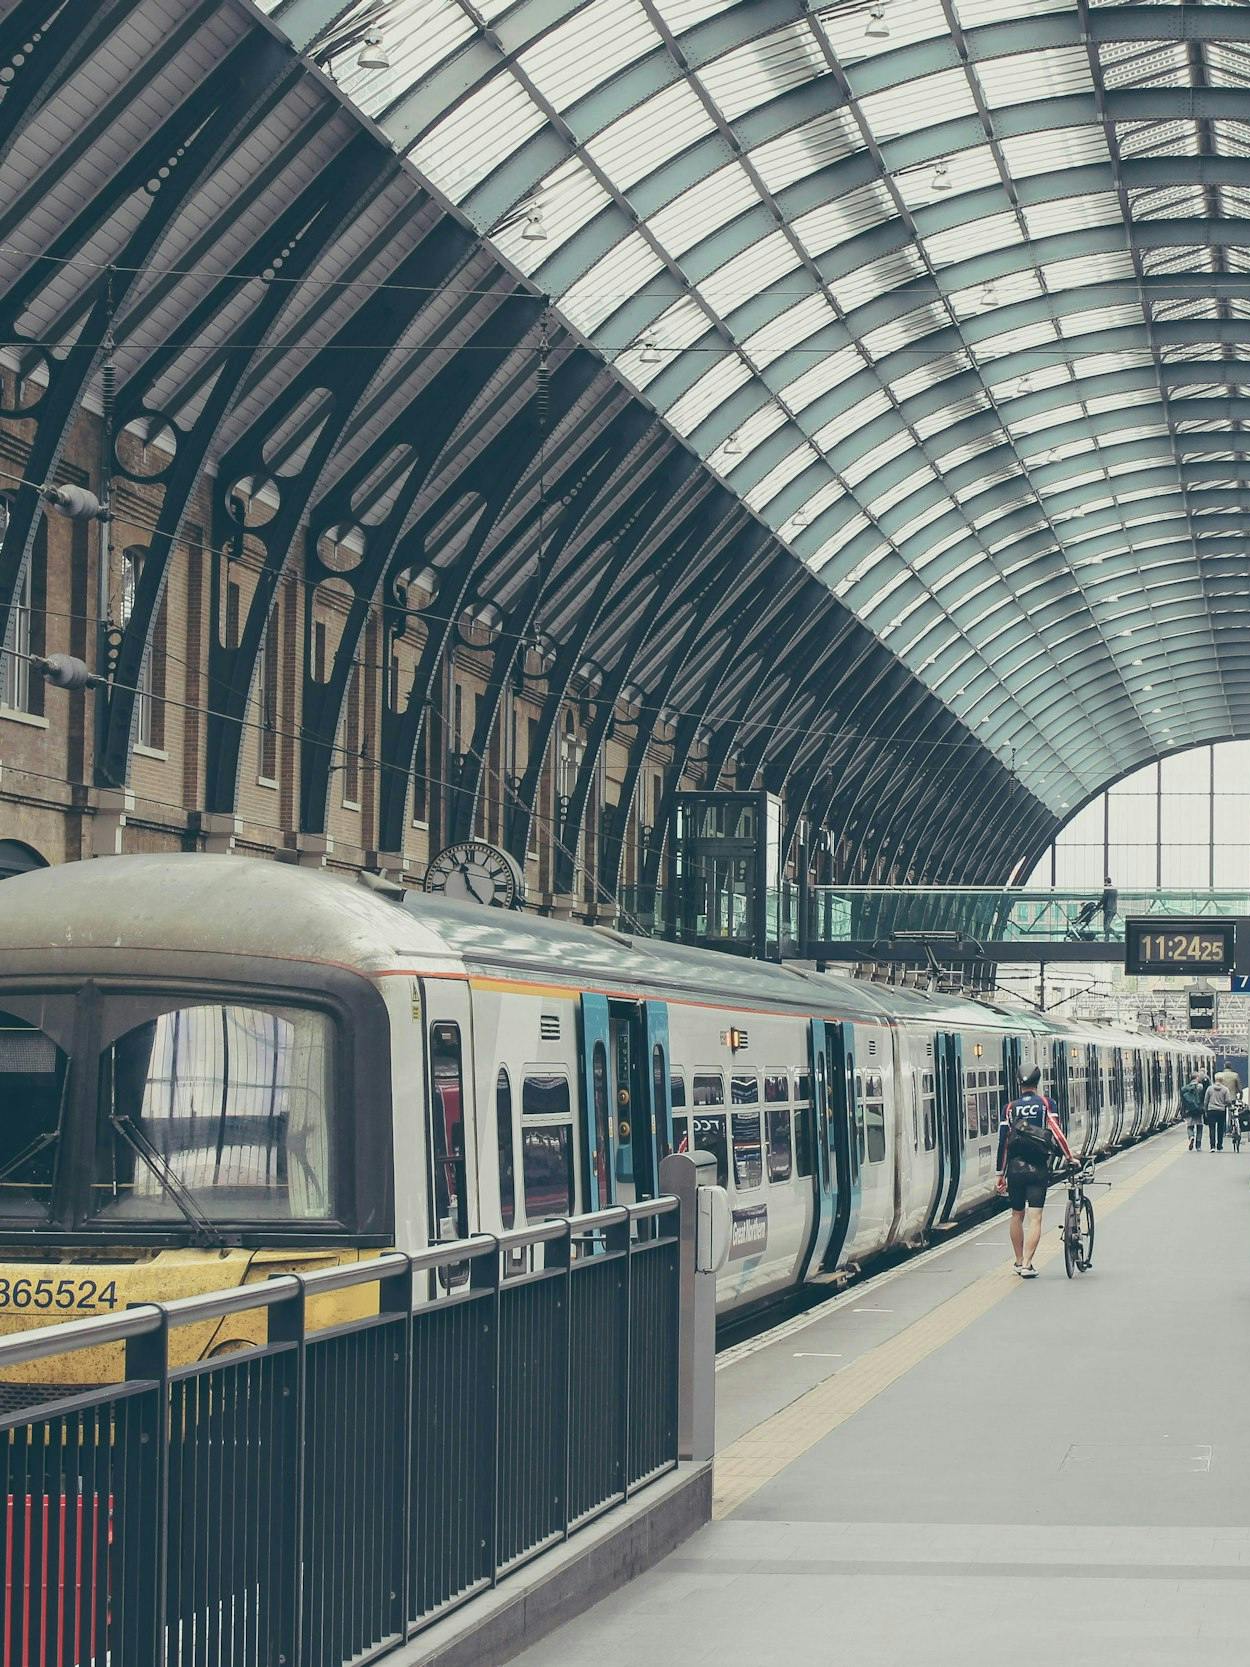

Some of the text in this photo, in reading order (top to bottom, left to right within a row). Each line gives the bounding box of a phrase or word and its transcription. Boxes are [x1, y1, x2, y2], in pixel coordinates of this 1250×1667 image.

[1239, 975, 1249, 988] 7
[1016, 1104, 1040, 1117] TCC
[0, 1278, 118, 1309] 365524
